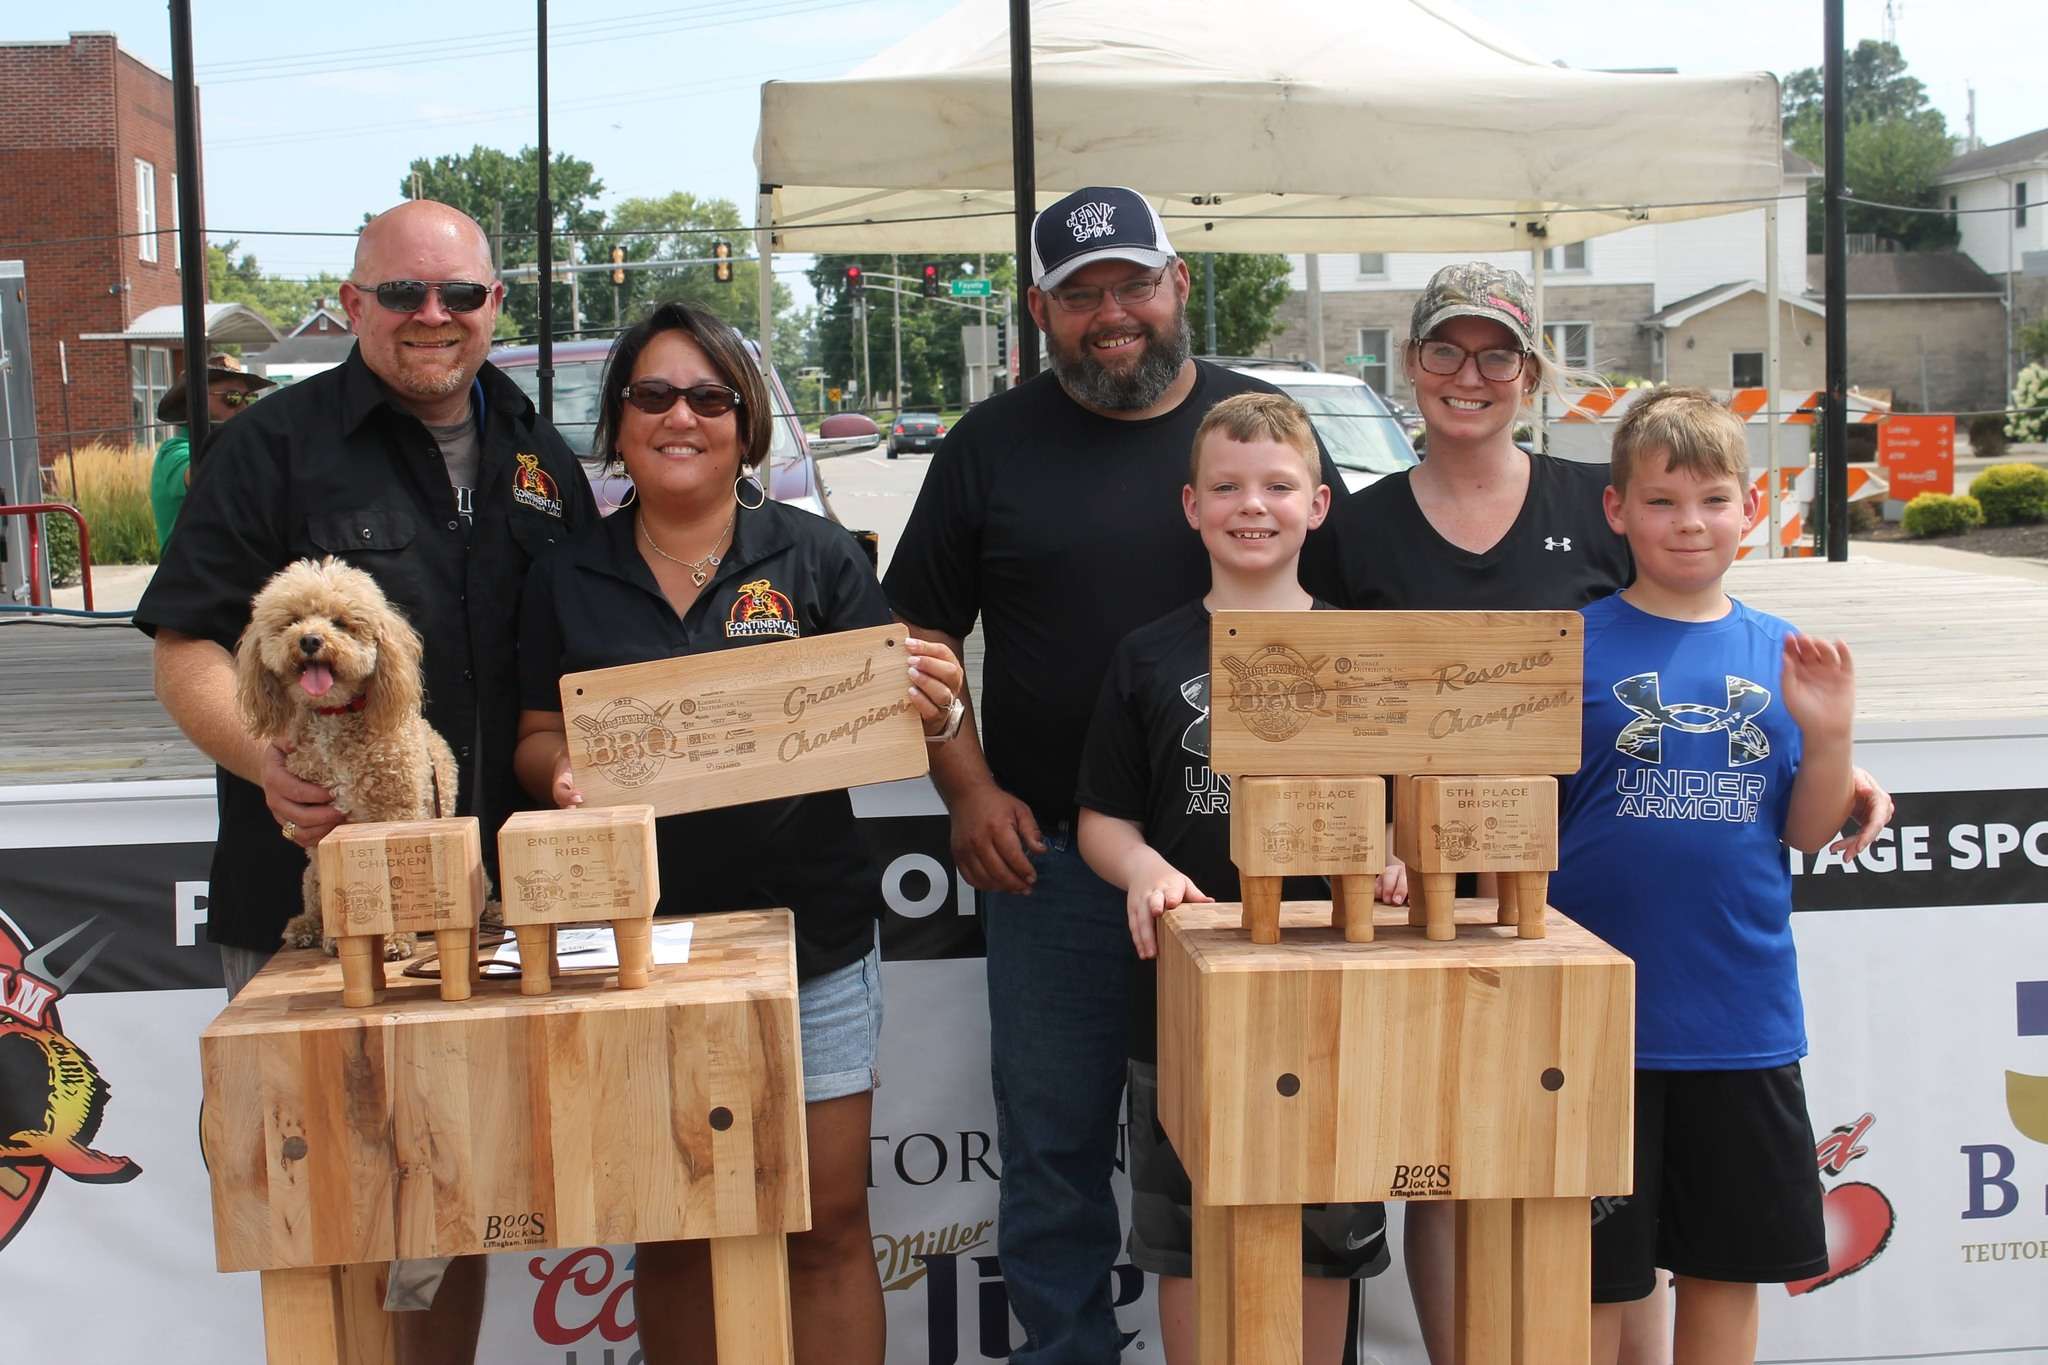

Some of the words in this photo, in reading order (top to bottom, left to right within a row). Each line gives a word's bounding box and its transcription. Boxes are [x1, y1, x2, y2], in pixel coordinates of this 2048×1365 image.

[728, 621, 798, 632] CONTINENTAL
[1432, 651, 1554, 695] Reserve
[784, 658, 875, 724] Grand
[1428, 691, 1574, 739] Champion
[778, 699, 913, 762] Champion
[583, 727, 687, 768] BBQ
[1446, 788, 1475, 797] 5TH
[1482, 787, 1529, 797] PLACE
[1616, 768, 1767, 801] UNDER
[1308, 790, 1356, 799] PLACE
[1296, 801, 1336, 811] PORK
[1458, 799, 1519, 809] BRISKET
[1616, 796, 1758, 822] ARMOUR
[527, 836, 559, 847] 2ND
[567, 832, 617, 845] PLACE
[349, 848, 377, 858] 1ST
[385, 844, 434, 855] PLACE
[555, 846, 591, 857] RIBS
[358, 856, 427, 870] CHICKEN
[870, 1220, 994, 1283] Miller
